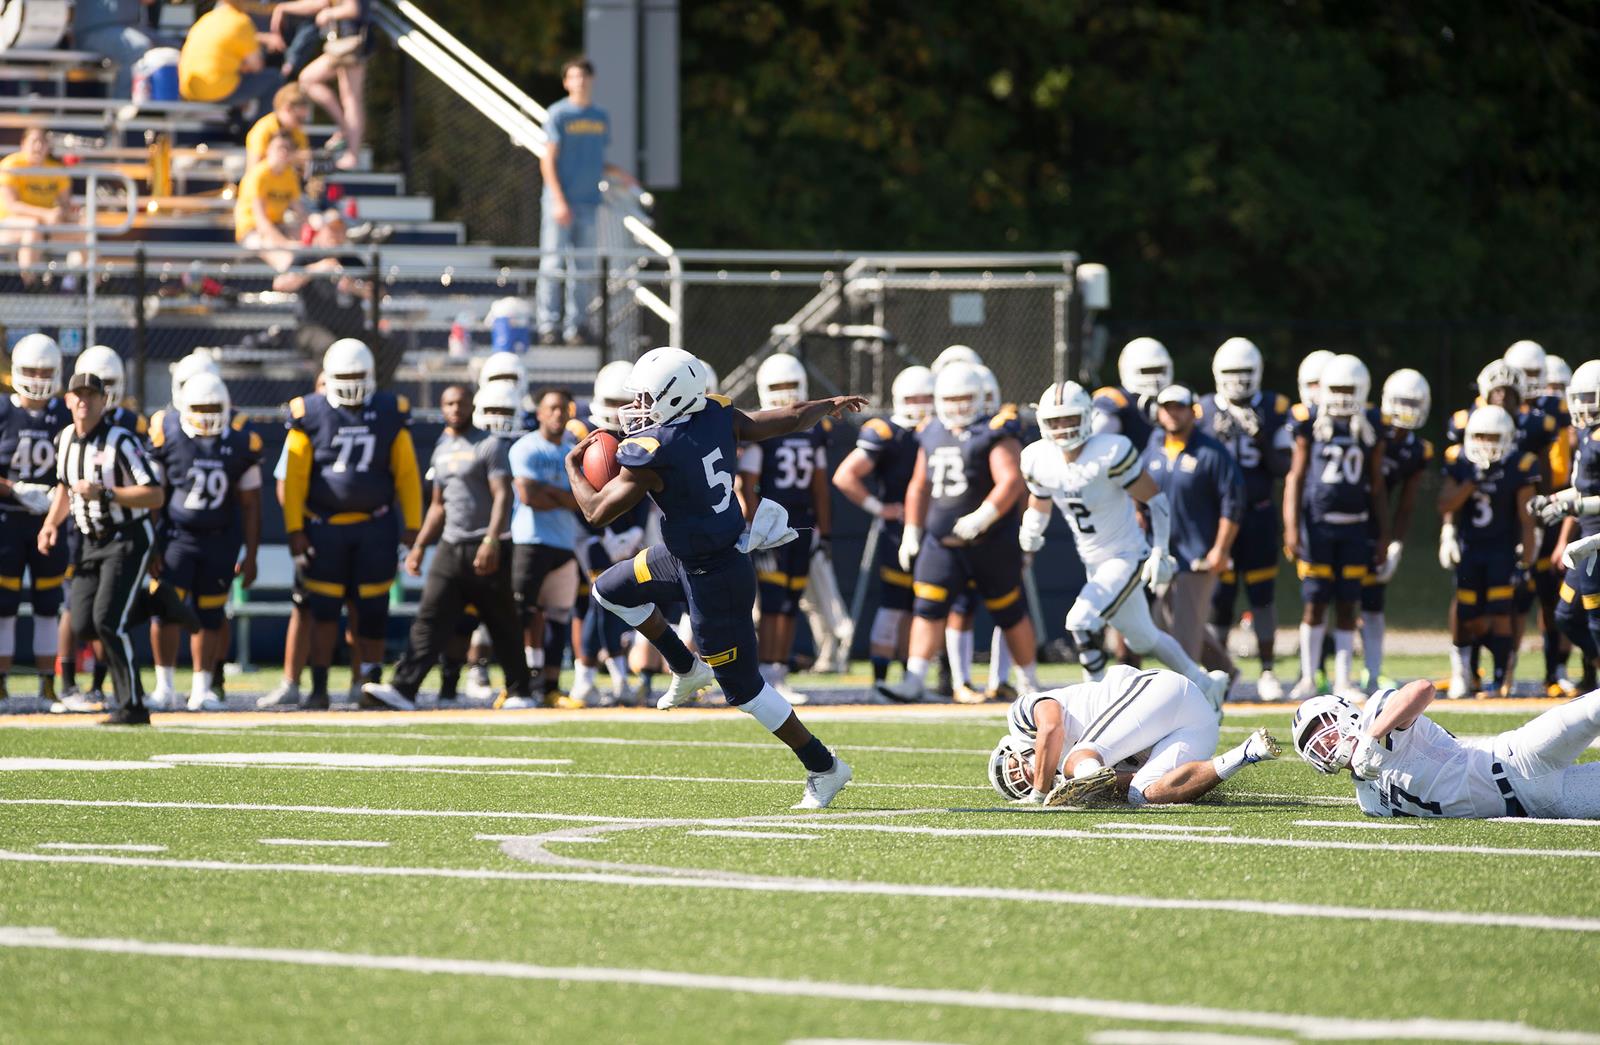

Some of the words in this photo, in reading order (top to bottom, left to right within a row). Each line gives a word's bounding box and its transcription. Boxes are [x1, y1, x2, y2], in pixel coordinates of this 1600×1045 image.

[11, 437, 54, 479] 49
[331, 434, 376, 473] 77
[774, 446, 814, 489] 35
[1321, 445, 1364, 484] 20
[184, 467, 229, 509] 29
[702, 446, 733, 514] 5
[928, 454, 969, 498] 73
[1068, 502, 1097, 534] 2
[1471, 491, 1493, 528] 3
